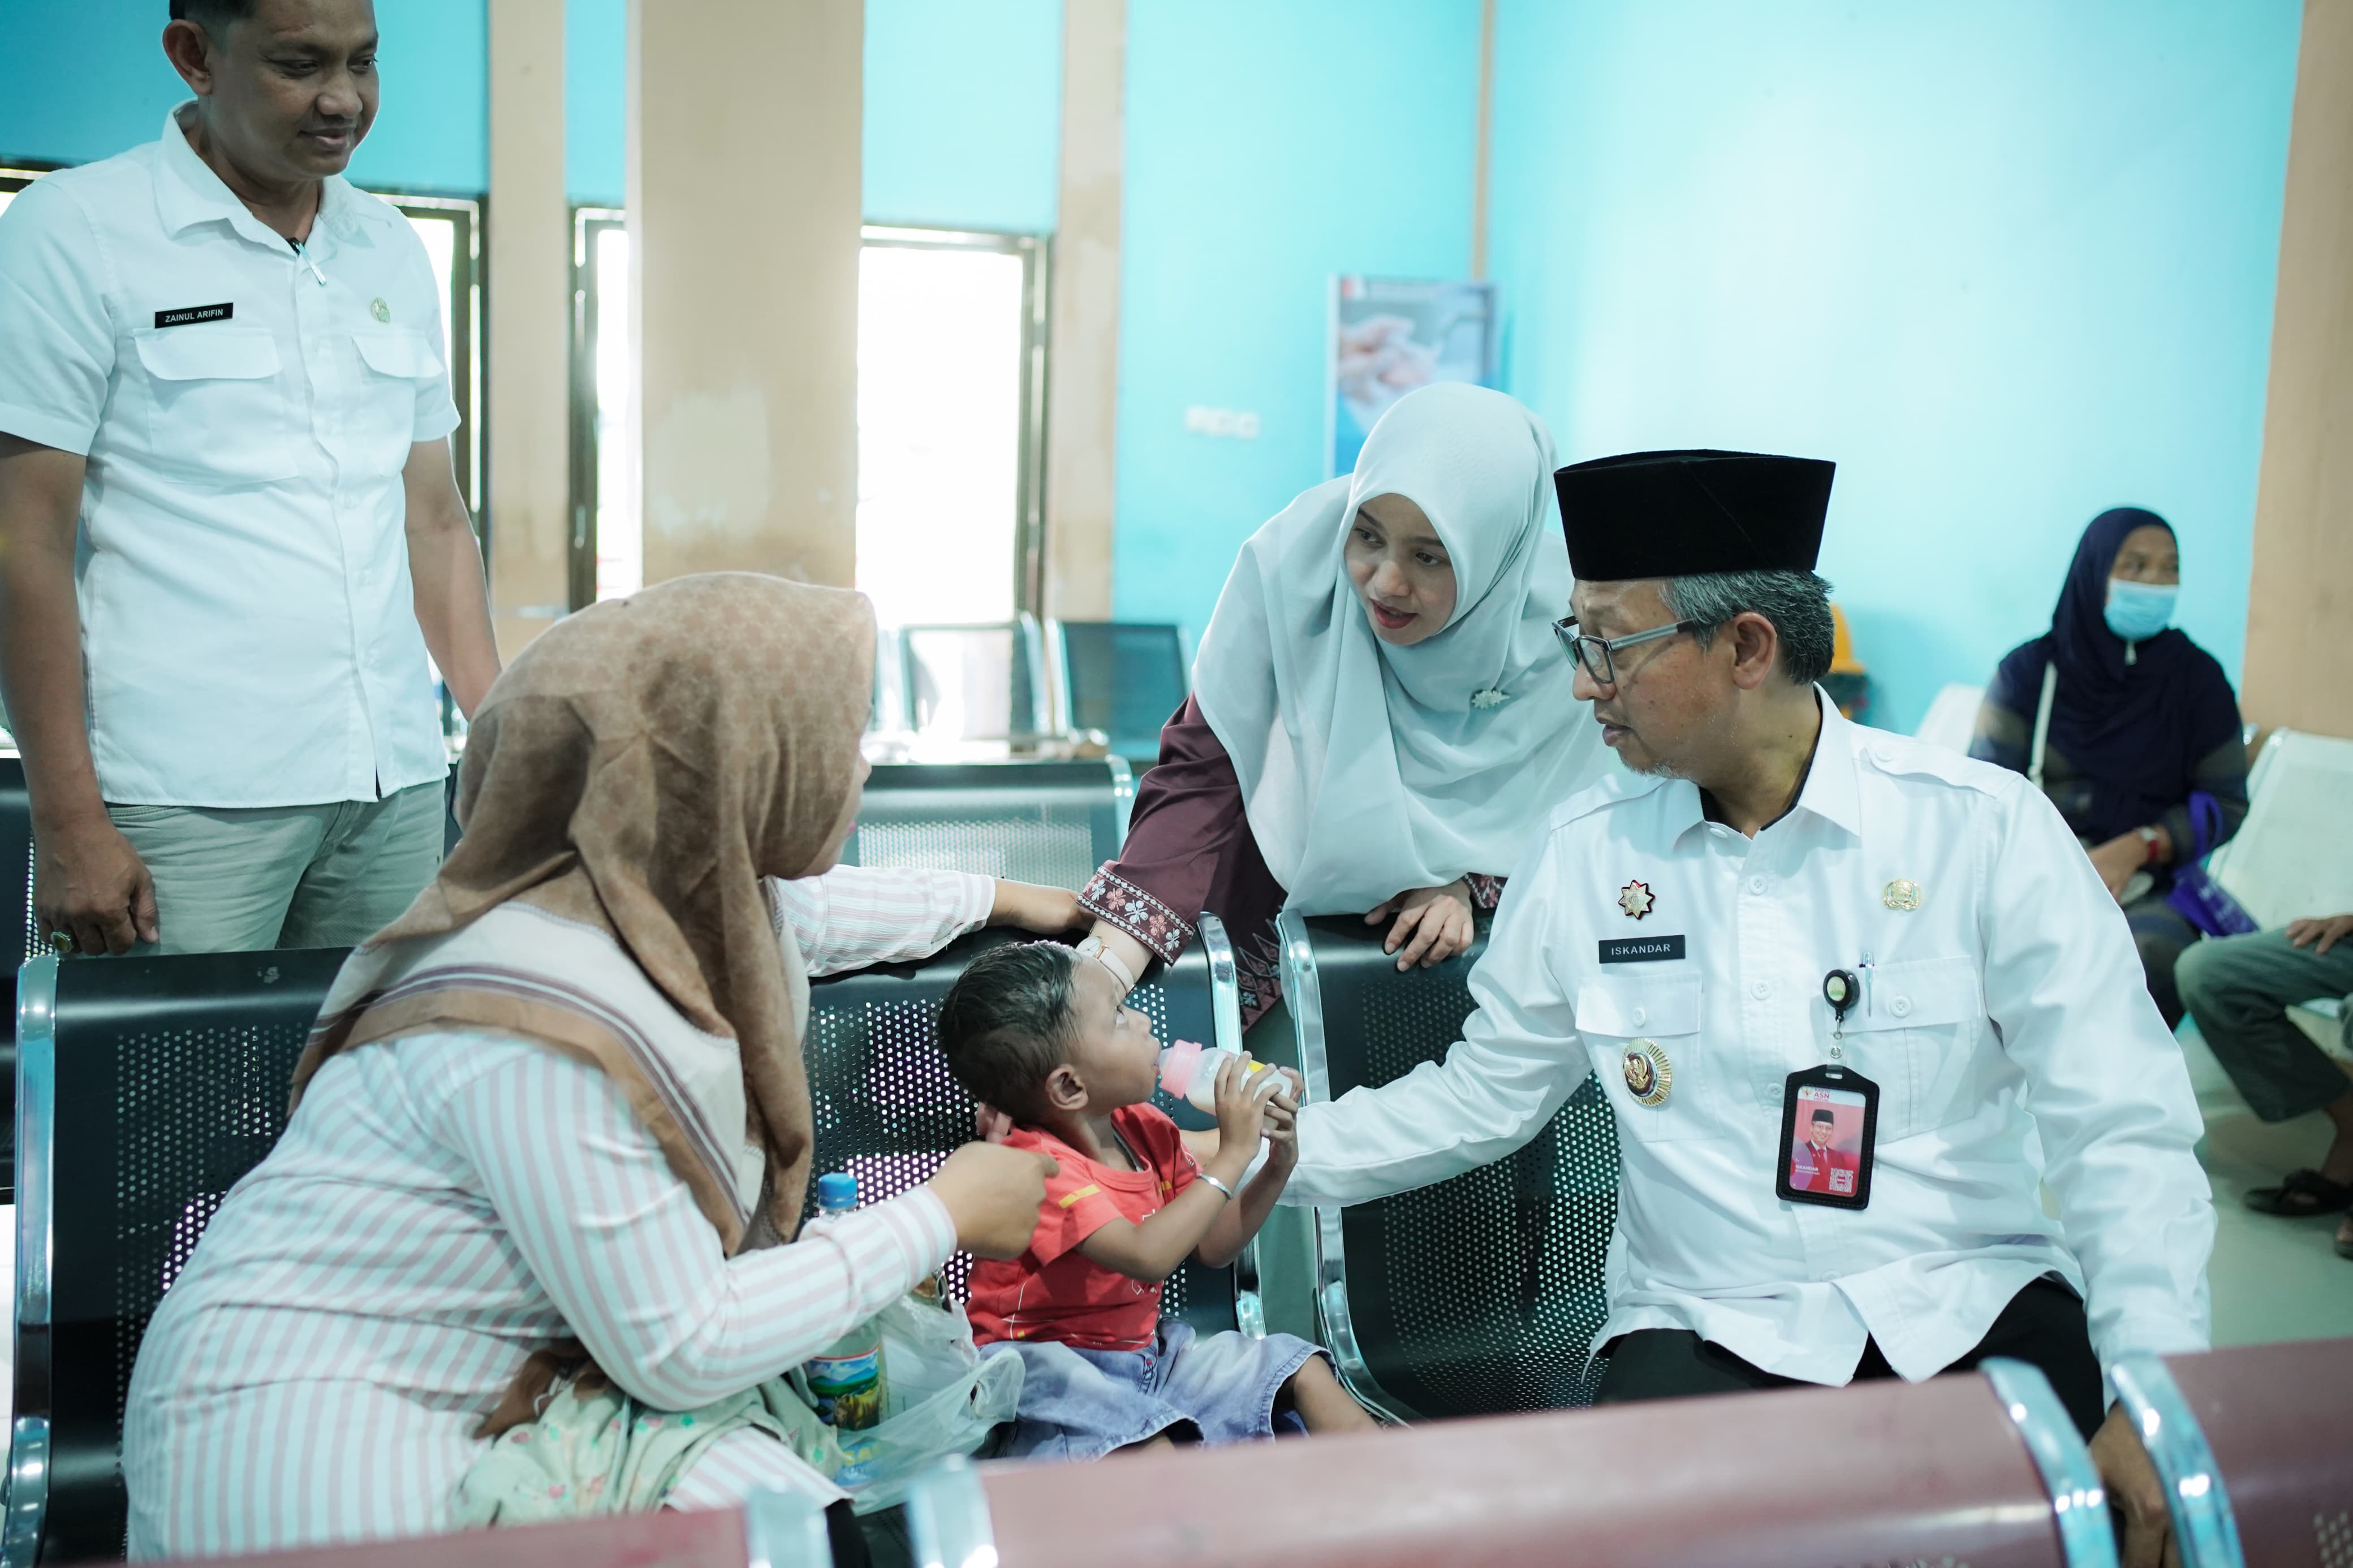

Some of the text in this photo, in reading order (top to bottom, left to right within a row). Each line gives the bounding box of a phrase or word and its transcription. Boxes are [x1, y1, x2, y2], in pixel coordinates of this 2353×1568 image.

[165, 308, 223, 323] ZAINUL ARIFIN
[1611, 943, 1670, 956] ISKANDAR
